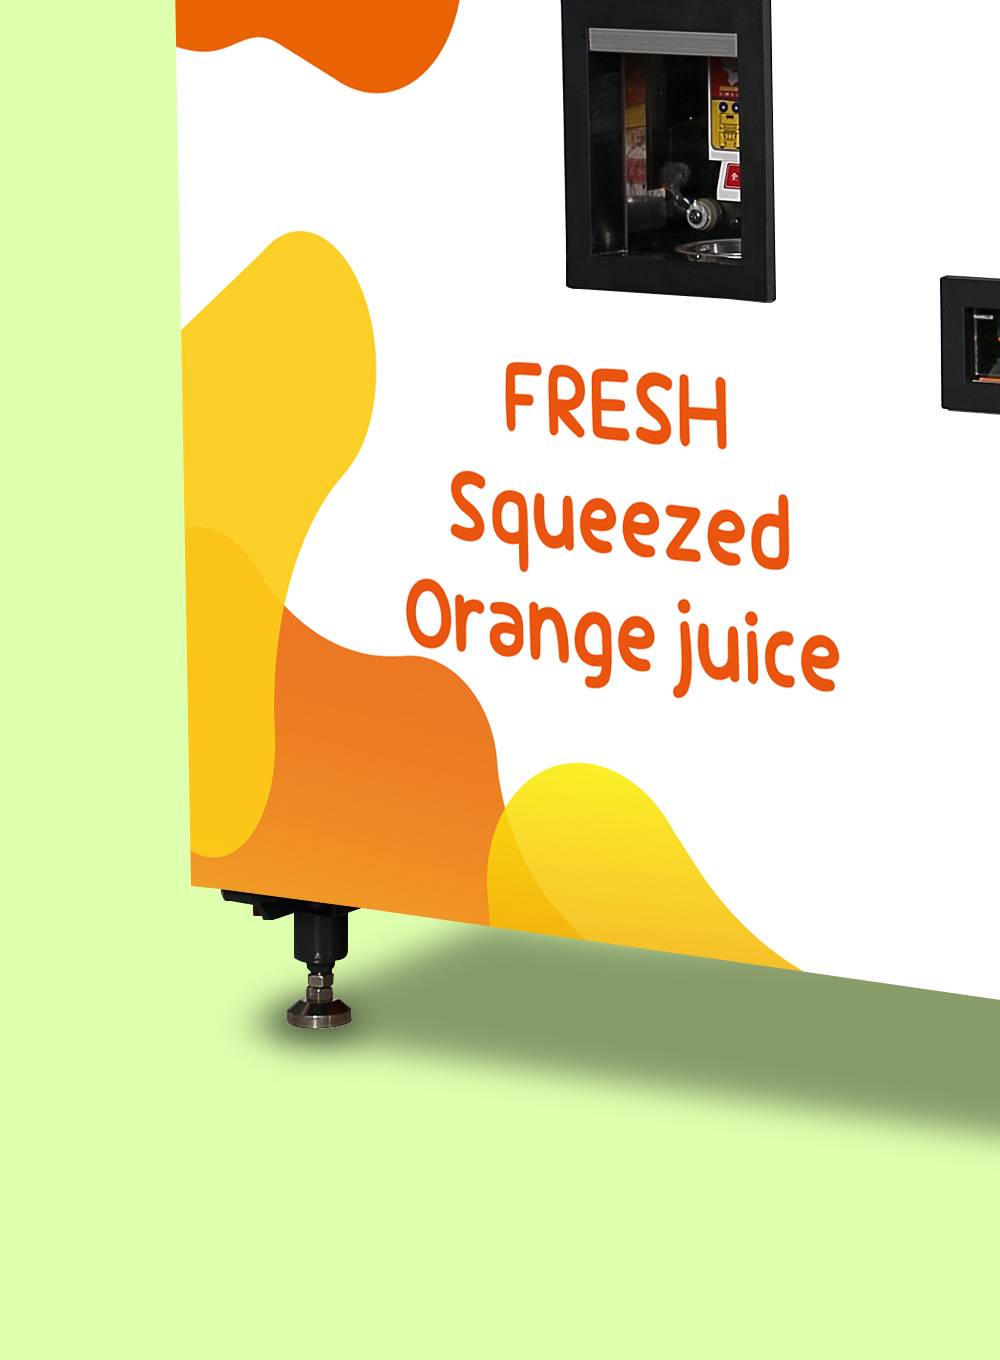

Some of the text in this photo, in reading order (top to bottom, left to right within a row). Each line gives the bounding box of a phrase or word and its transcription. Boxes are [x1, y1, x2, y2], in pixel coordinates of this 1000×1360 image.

[505, 362, 727, 449] FRESH
[450, 470, 790, 572] Squeezed
[405, 578, 840, 698] Orange juice
